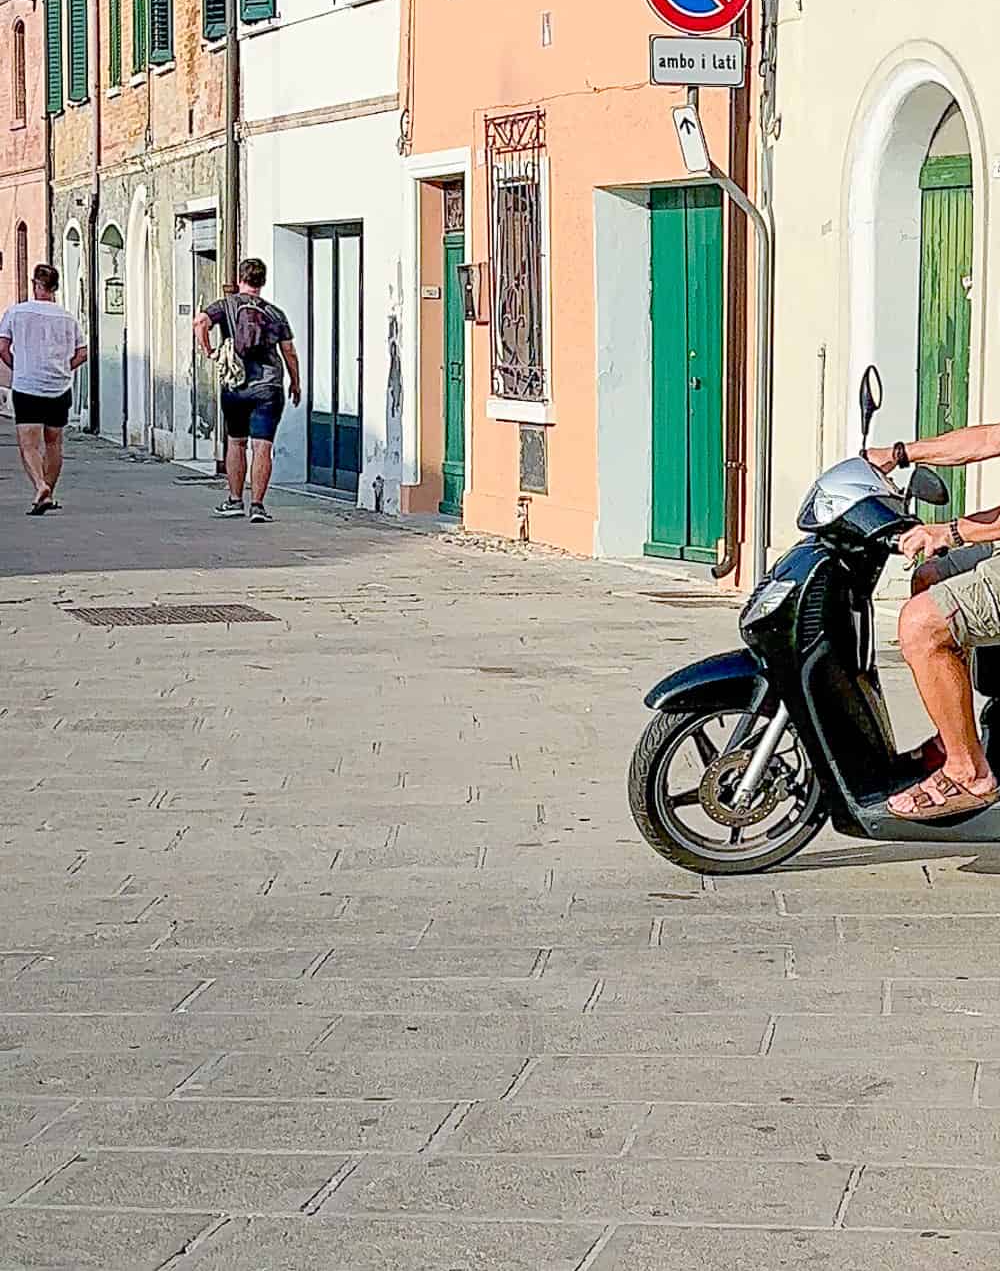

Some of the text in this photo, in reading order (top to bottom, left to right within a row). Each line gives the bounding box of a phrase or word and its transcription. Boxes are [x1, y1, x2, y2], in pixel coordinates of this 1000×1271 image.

[658, 52, 737, 70] ambo i lati
